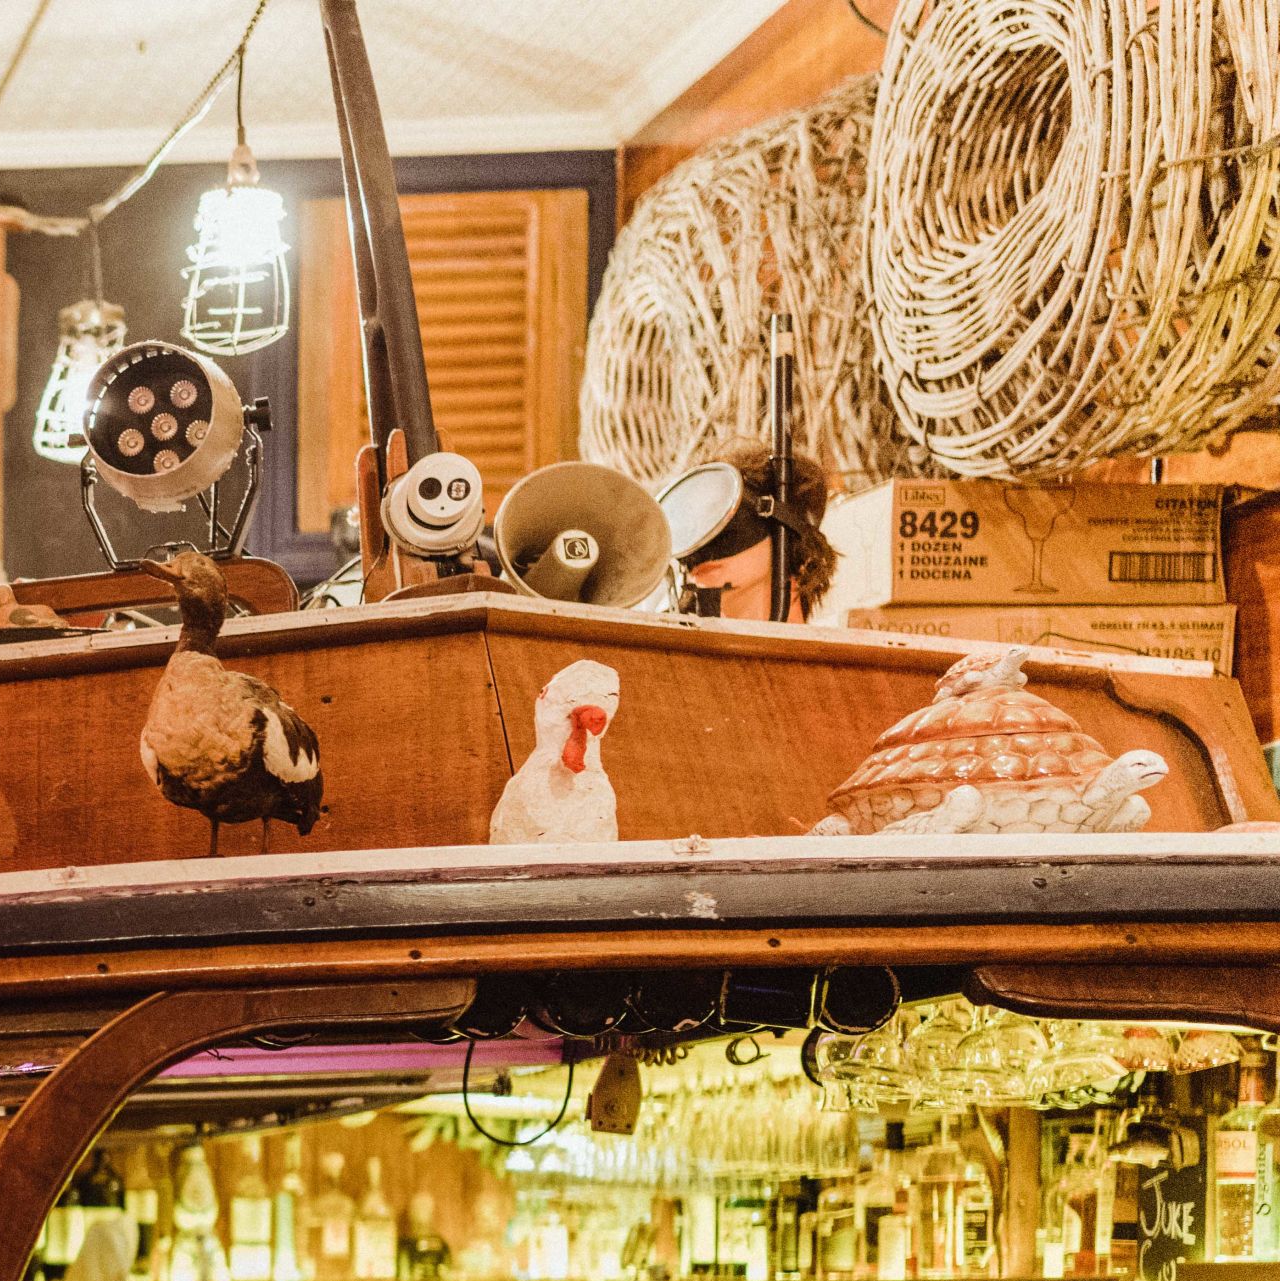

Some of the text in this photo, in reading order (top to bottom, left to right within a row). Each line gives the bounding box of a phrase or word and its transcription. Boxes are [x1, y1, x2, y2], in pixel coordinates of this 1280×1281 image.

[898, 510, 980, 539] 8429
[898, 541, 963, 553] 1 DOZEN
[898, 555, 989, 568] 1 DOUZAINE
[898, 569, 973, 581] 1 DOCENA
[1139, 1169, 1197, 1246] JUKE
